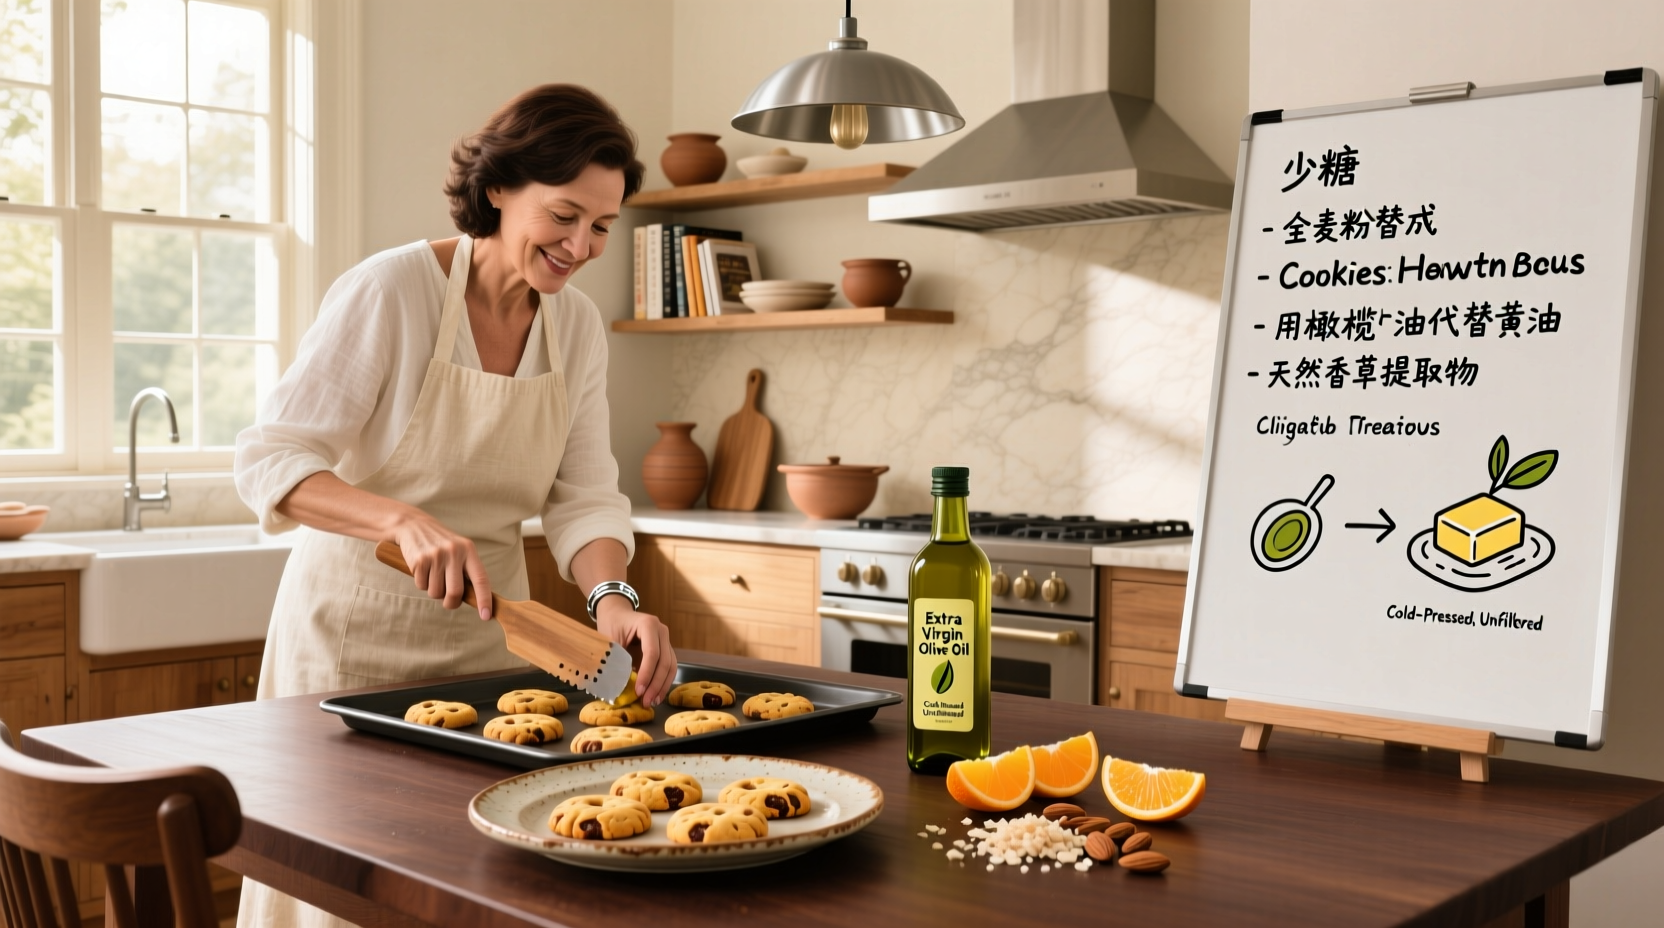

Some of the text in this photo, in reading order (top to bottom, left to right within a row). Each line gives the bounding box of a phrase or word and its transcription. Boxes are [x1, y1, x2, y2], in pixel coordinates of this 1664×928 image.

[1280, 143, 1361, 194] 少糖
[1267, 353, 1480, 390] 天然香草提取物
[925, 611, 963, 626] Extra
[1386, 604, 1476, 627] Cold-Pressed,
[921, 626, 964, 645] Virgin
[918, 642, 970, 656] Olive Oil
